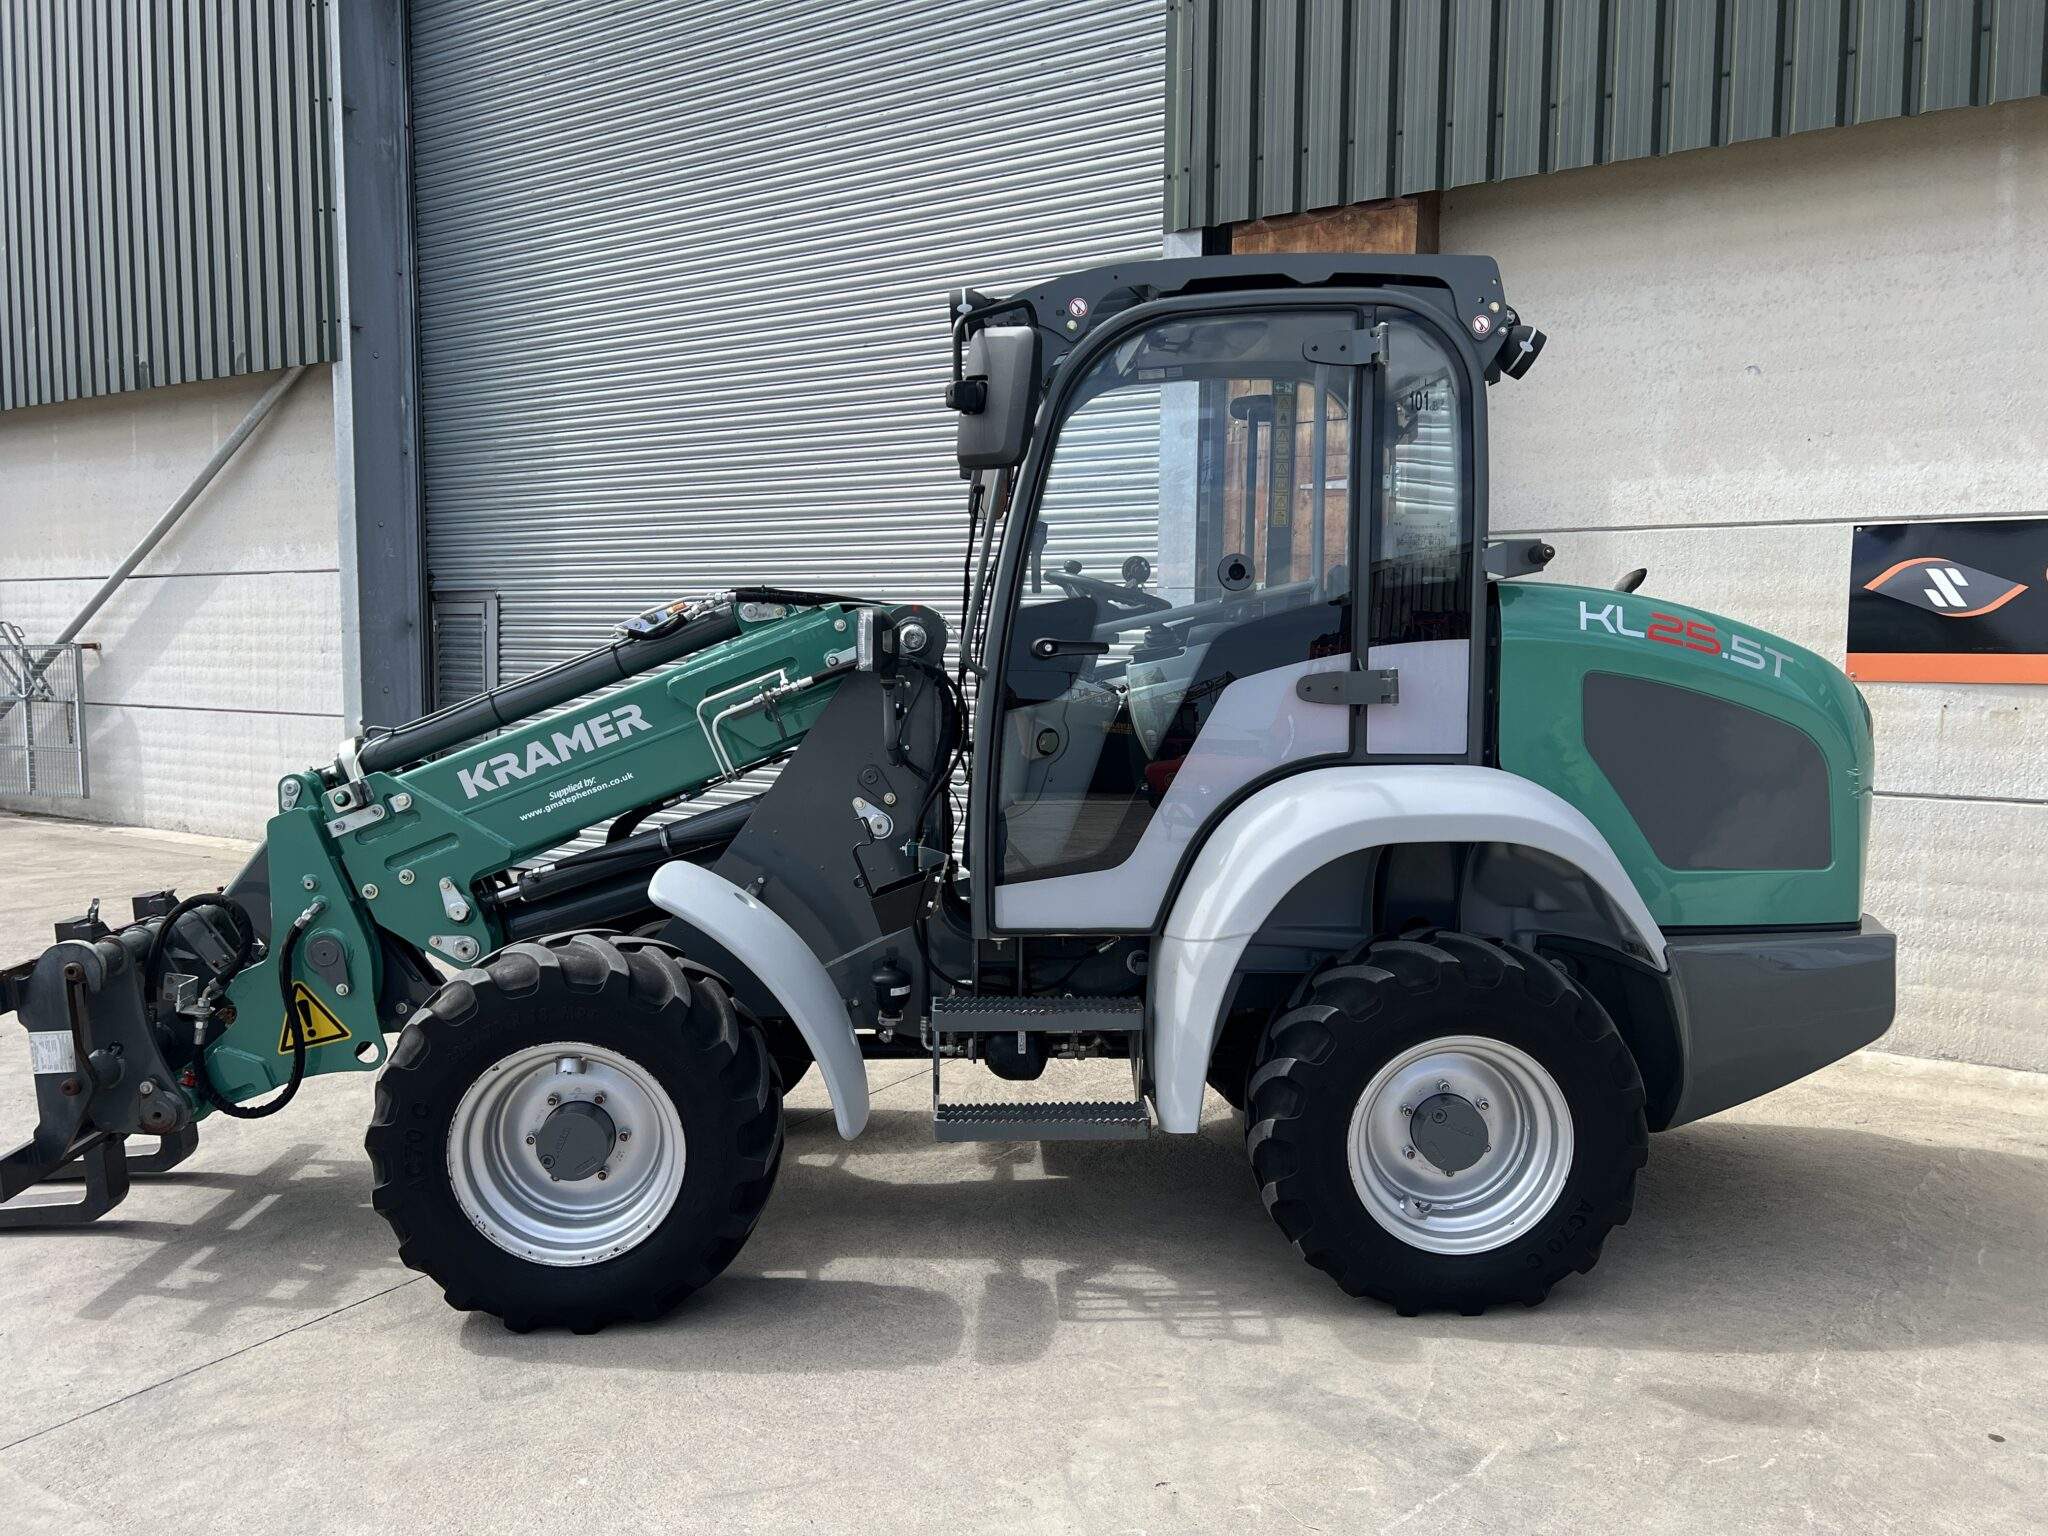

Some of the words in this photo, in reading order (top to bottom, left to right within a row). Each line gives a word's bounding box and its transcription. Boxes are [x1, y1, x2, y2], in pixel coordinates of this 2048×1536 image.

[1410, 391, 1429, 411] 101
[1579, 600, 1794, 678] KL25.5T
[457, 704, 653, 799] KRAMER
[520, 772, 634, 821] www.gmstephenson.co.uk
[550, 780, 584, 800] Supplied
